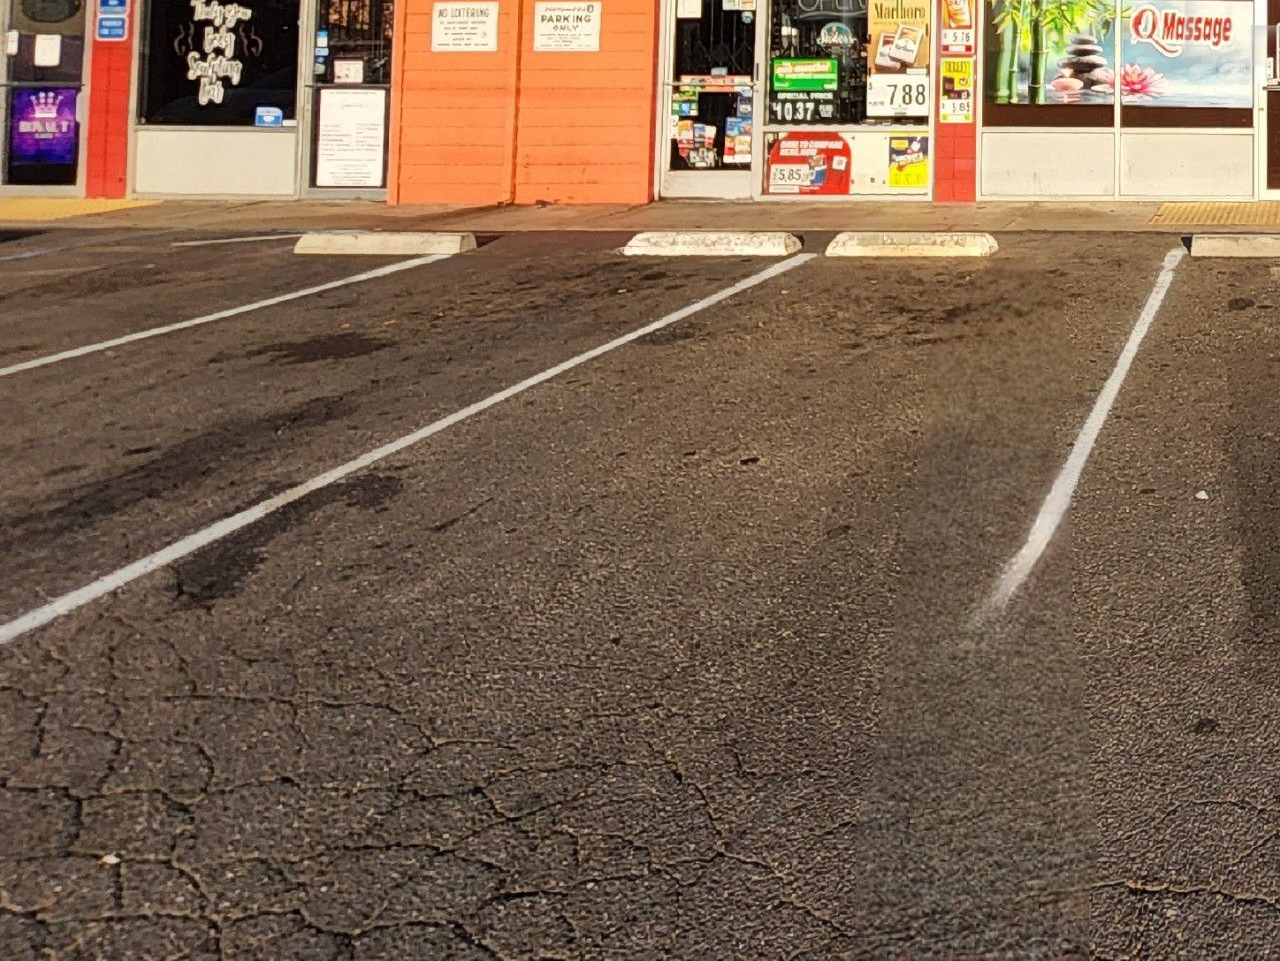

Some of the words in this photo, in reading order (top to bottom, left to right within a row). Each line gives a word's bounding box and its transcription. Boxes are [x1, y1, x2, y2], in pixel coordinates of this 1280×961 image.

[540, 14, 592, 23] PARKING
[1132, 8, 1179, 54] Q
[1162, 13, 1233, 46] Massage
